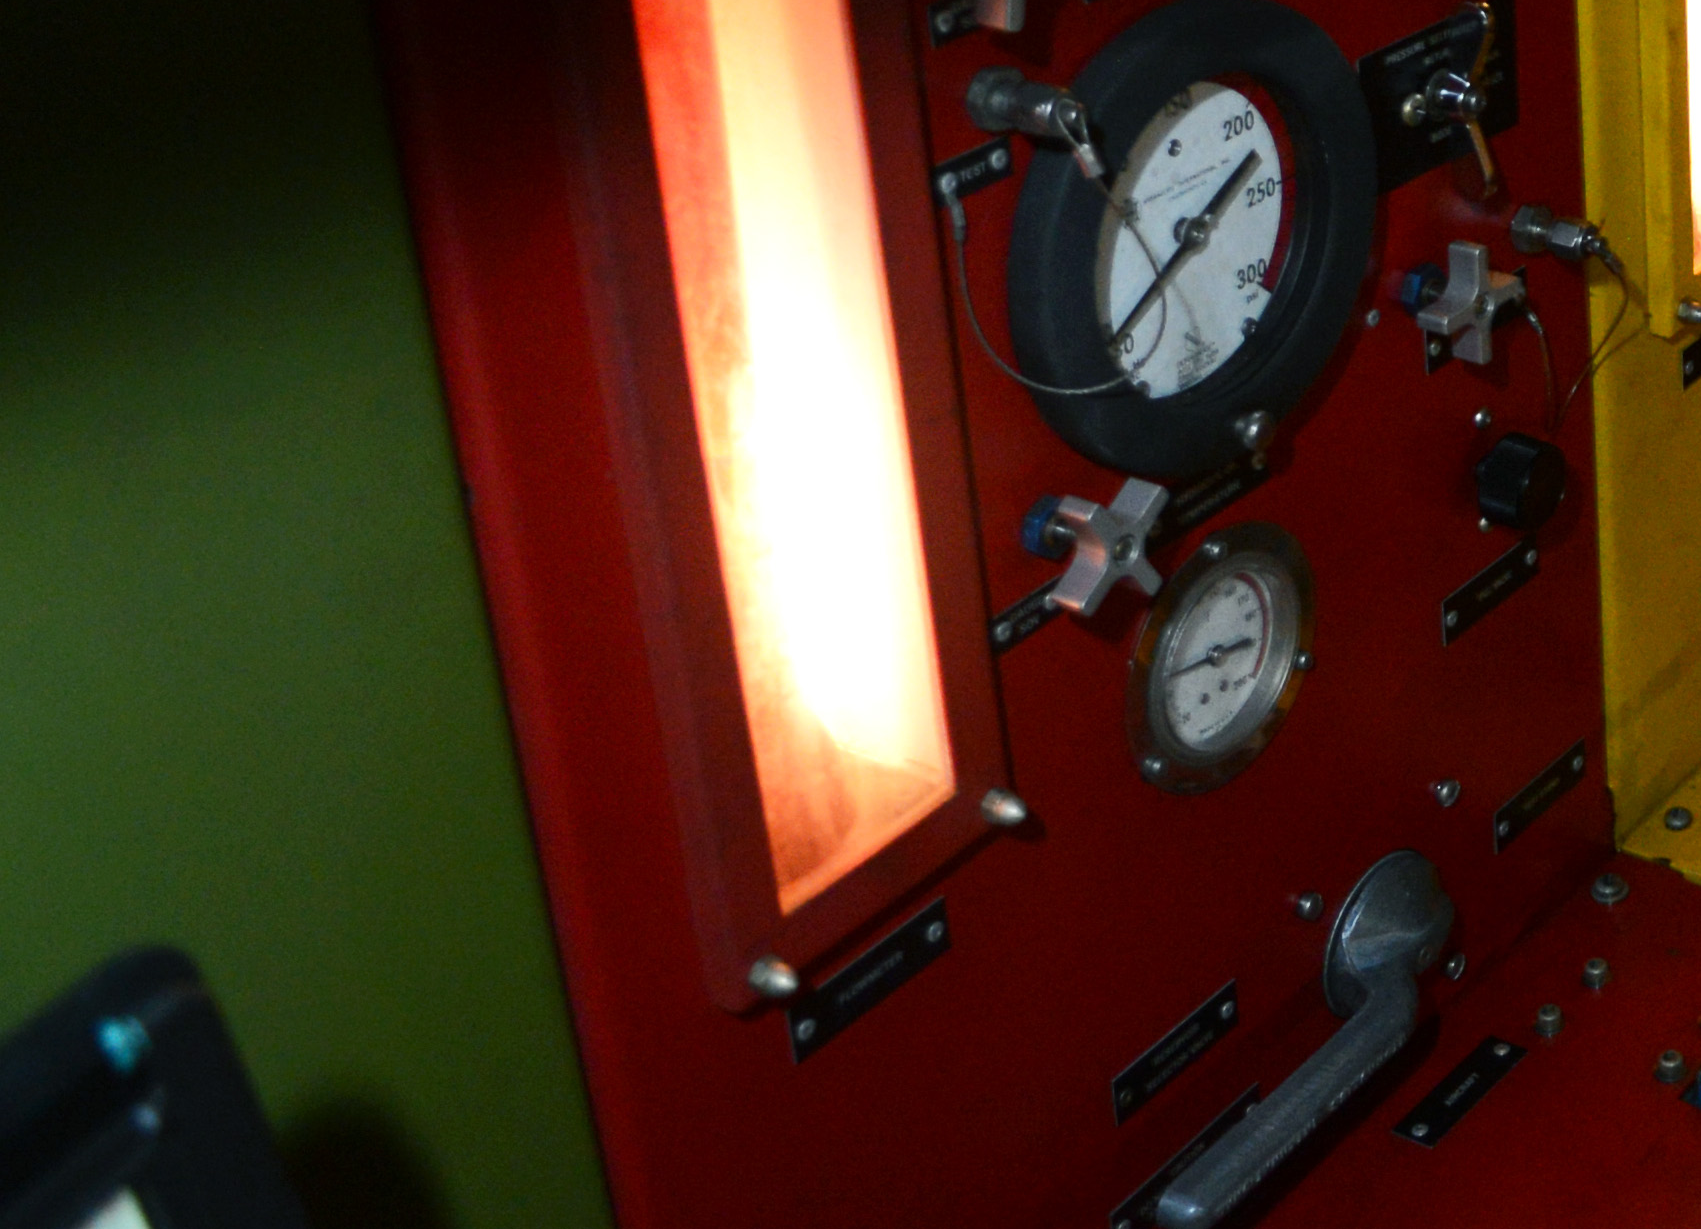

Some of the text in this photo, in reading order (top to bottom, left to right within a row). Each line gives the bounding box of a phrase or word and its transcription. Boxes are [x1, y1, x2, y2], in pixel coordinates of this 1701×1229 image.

[1223, 110, 1255, 142] 200
[960, 160, 986, 183] TEST
[1246, 177, 1276, 209] 250
[1237, 258, 1267, 290] 300
